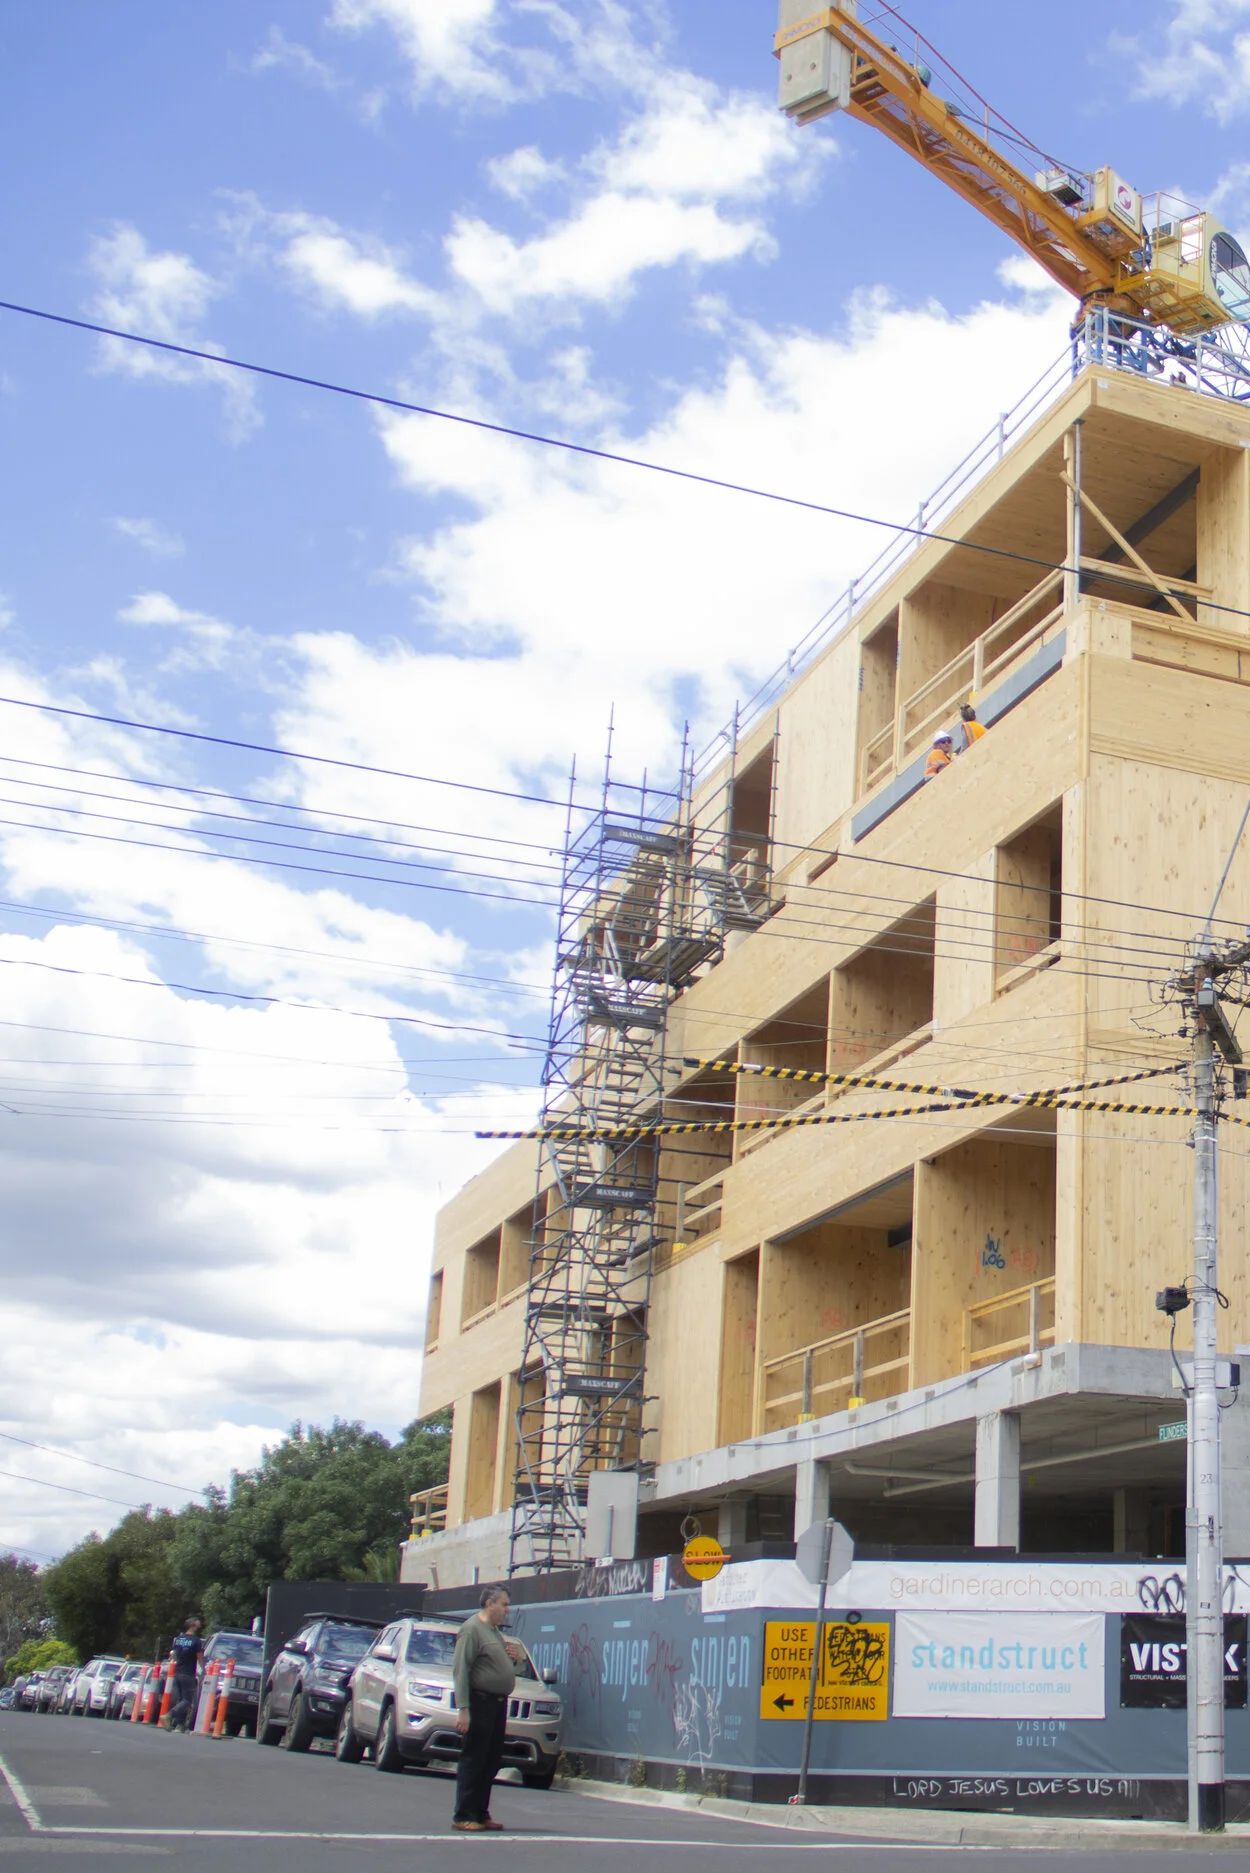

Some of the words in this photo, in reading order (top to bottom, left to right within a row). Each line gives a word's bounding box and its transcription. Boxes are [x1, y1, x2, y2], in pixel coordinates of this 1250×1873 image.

[686, 1551, 721, 1565] SLOW
[890, 1574, 1138, 1599] gardinerarch.com.au
[781, 1628, 808, 1641] USE
[911, 1638, 1088, 1670] standstruct
[602, 1638, 649, 1702] sinjen
[690, 1635, 749, 1706] sinjen
[927, 1679, 1072, 1695] www.standstruct.com.au
[1016, 1720, 1067, 1732] VISION
[1016, 1735, 1057, 1747] BUILT
[893, 1777, 941, 1797] LORD
[950, 1779, 1009, 1795] JESUS
[1017, 1779, 1081, 1796] LOVES
[1087, 1778, 1113, 1796] US
